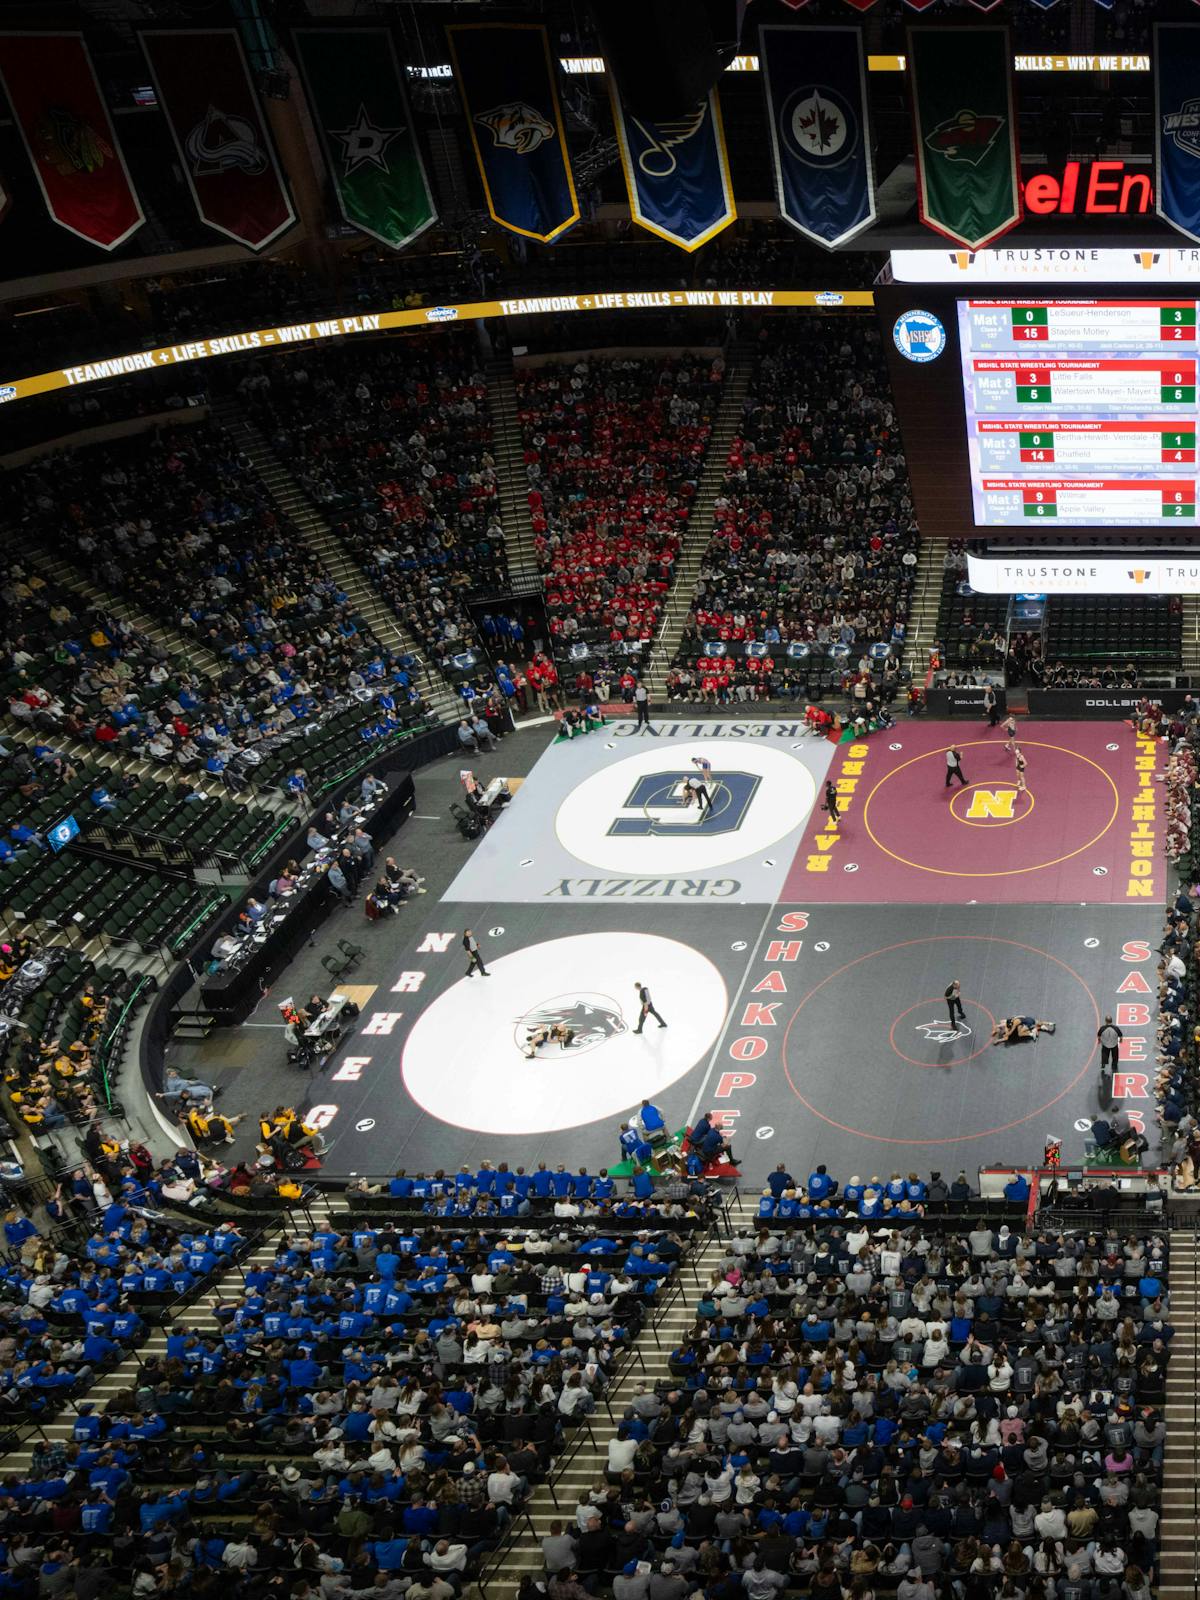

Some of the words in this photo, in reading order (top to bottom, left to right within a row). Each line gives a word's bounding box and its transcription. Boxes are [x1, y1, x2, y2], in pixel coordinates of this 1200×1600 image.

[1015, 56, 1053, 70] SKILLS
[1067, 56, 1094, 70] WHY
[1100, 56, 1118, 70] WE
[1122, 56, 1150, 70] PLAY
[1022, 161, 1080, 214] el
[1085, 161, 1153, 214] En
[500, 296, 580, 315] TEAMWORK
[595, 293, 624, 308] LIFE
[627, 292, 671, 306] SKILLS
[685, 292, 715, 305] WHY
[718, 292, 740, 305] WE
[742, 292, 774, 305] PLAY
[974, 314, 1000, 326] Mat
[1003, 314, 1008, 325] 1
[1026, 311, 1034, 321] 0
[1174, 311, 1182, 322] 3
[1024, 328, 1037, 338] 15
[1174, 328, 1182, 338] 2
[62, 351, 156, 385] TEAMWORK
[173, 342, 206, 363] LIFE
[210, 332, 262, 356] SKILLS
[277, 324, 313, 344] WHY
[315, 321, 340, 337] WE
[343, 315, 381, 334] PLAY
[978, 376, 1004, 388] Mat
[1005, 377, 1012, 388] 8
[1030, 374, 1036, 383] 3
[1174, 374, 1182, 383] 0
[1030, 390, 1038, 400] 5
[1174, 390, 1182, 400] 5
[984, 438, 1010, 449] Mat
[1010, 438, 1016, 449] 3
[1033, 436, 1040, 445] 0
[1176, 436, 1182, 445] 1
[1032, 451, 1044, 460] 14
[1174, 452, 1182, 460] 4
[987, 494, 1012, 505] Mat
[1013, 494, 1020, 505] 5
[1036, 492, 1044, 501] 9
[1175, 492, 1182, 502] 6
[1037, 506, 1044, 514] 6
[1083, 505, 1106, 514] Valley
[1175, 506, 1182, 514] 2
[1004, 568, 1097, 577] TRUSTONE
[614, 724, 812, 738] RESTLING
[967, 790, 1017, 818] N
[544, 878, 743, 897] GRIZZLY
